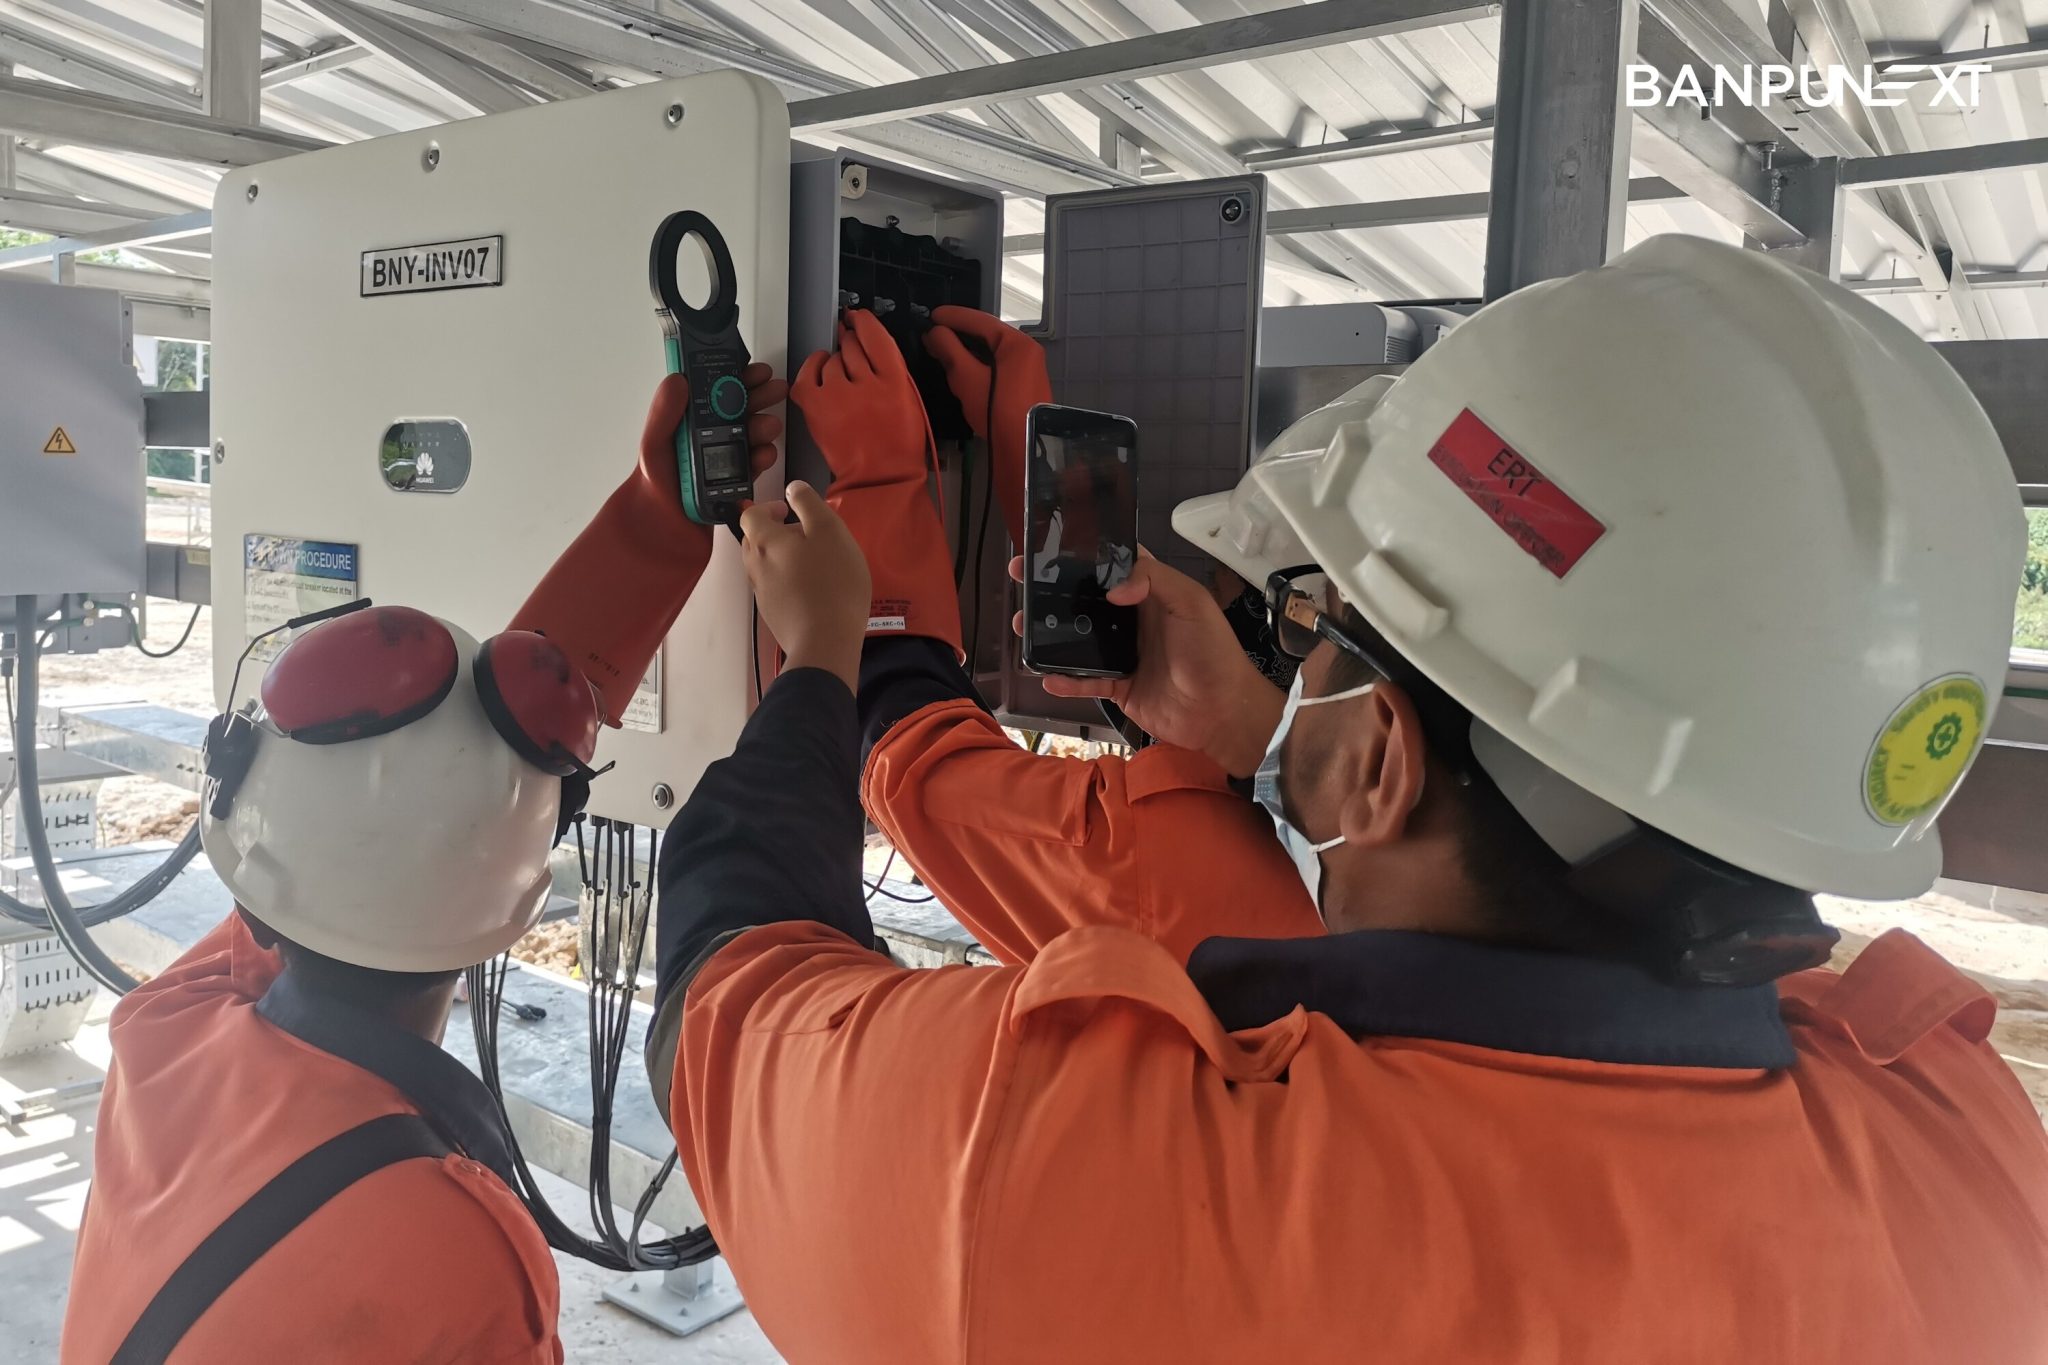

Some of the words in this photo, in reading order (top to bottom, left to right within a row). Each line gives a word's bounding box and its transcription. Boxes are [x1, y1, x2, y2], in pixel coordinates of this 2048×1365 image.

[373, 247, 489, 287] BNY-INV07
[1487, 448, 1542, 496] ERT
[296, 550, 352, 570] PROCEDURE
